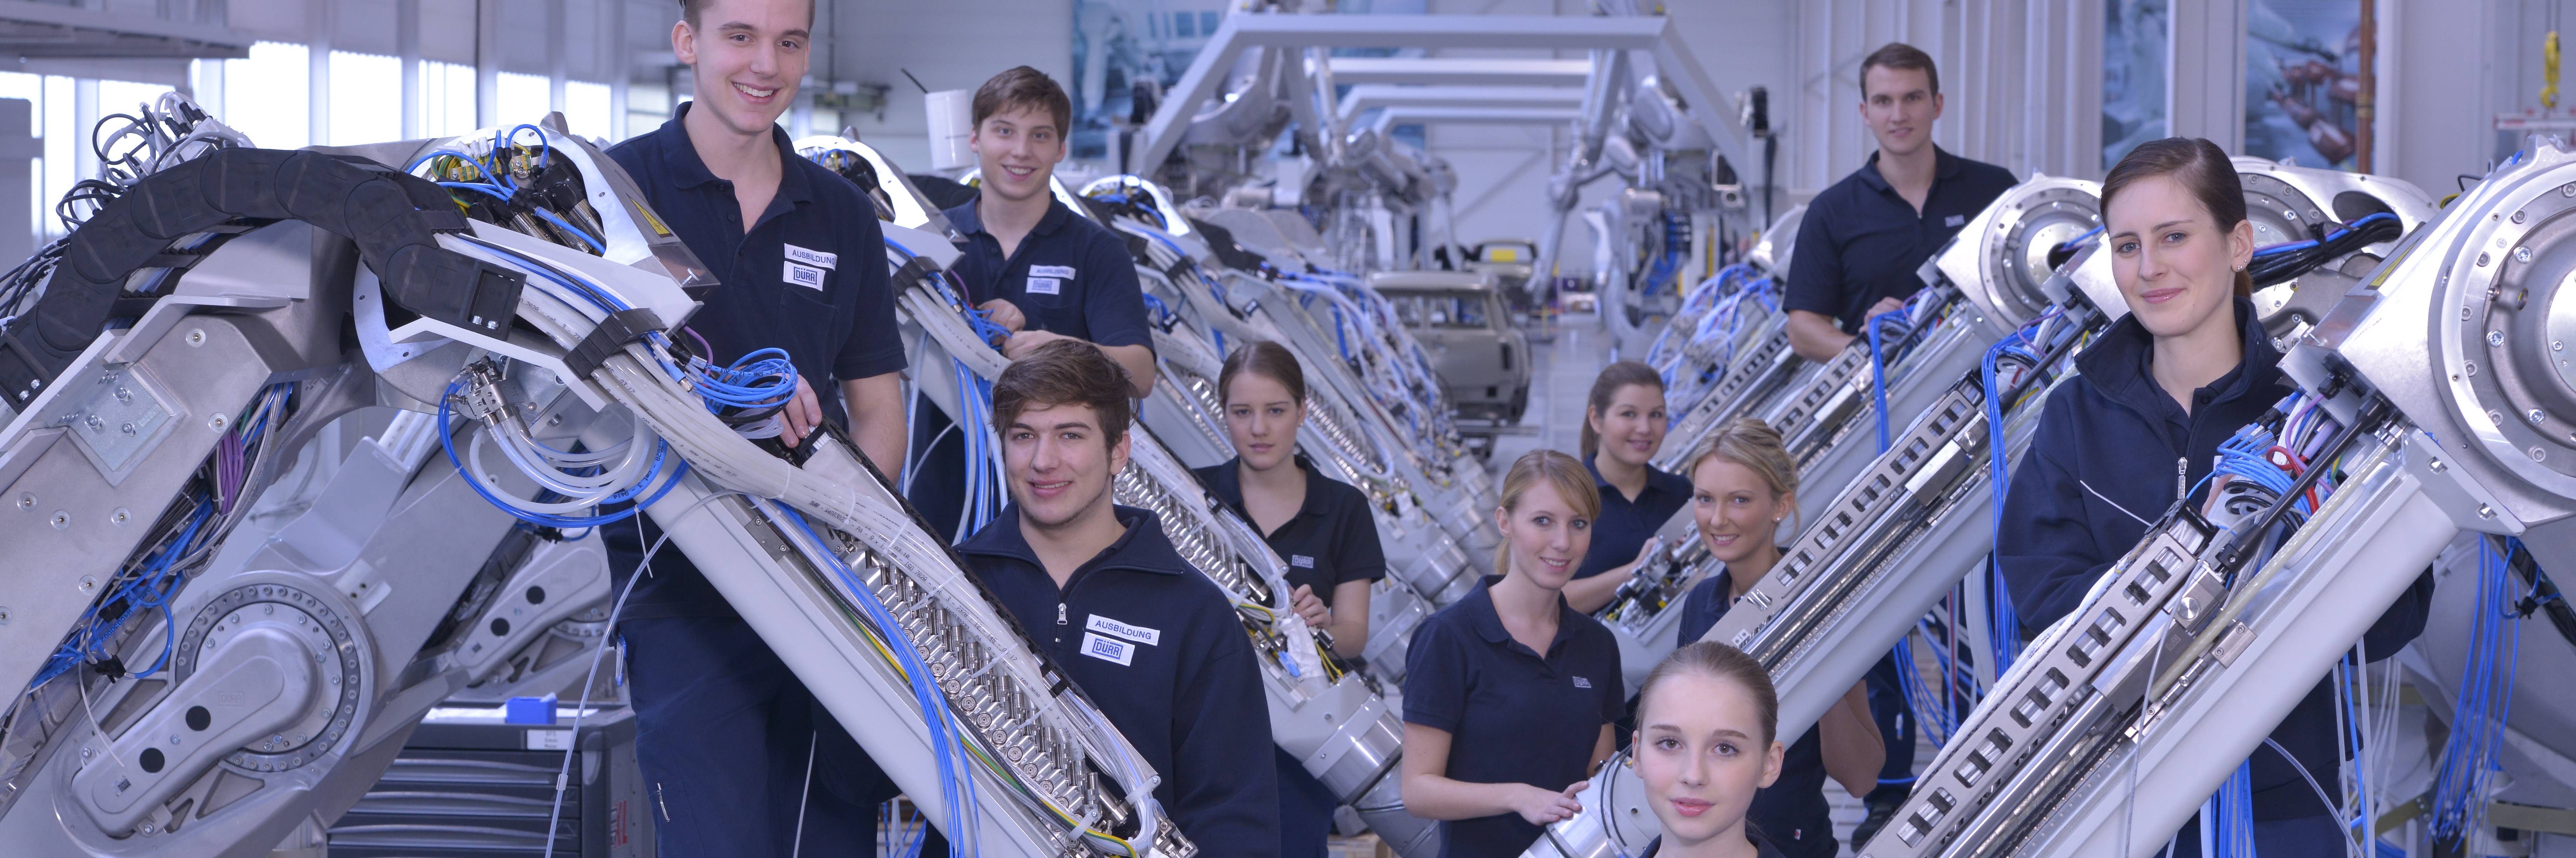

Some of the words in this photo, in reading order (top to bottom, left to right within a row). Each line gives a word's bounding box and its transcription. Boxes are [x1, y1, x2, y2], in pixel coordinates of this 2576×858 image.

[792, 249, 835, 265] AUSBILDUNG
[795, 268, 815, 282] DÜRR
[655, 445, 664, 462] 7628
[642, 470, 652, 481] cat
[614, 491, 629, 499] 9414
[1294, 555, 1312, 566] DÜRR
[904, 561, 914, 571] ISO
[914, 569, 928, 582] 7628
[956, 605, 970, 617] 7378
[987, 634, 998, 645] 145
[101, 609, 133, 642] W40030002
[1095, 620, 1152, 640] AUSBILDUNG
[1095, 640, 1120, 656] DÜRR
